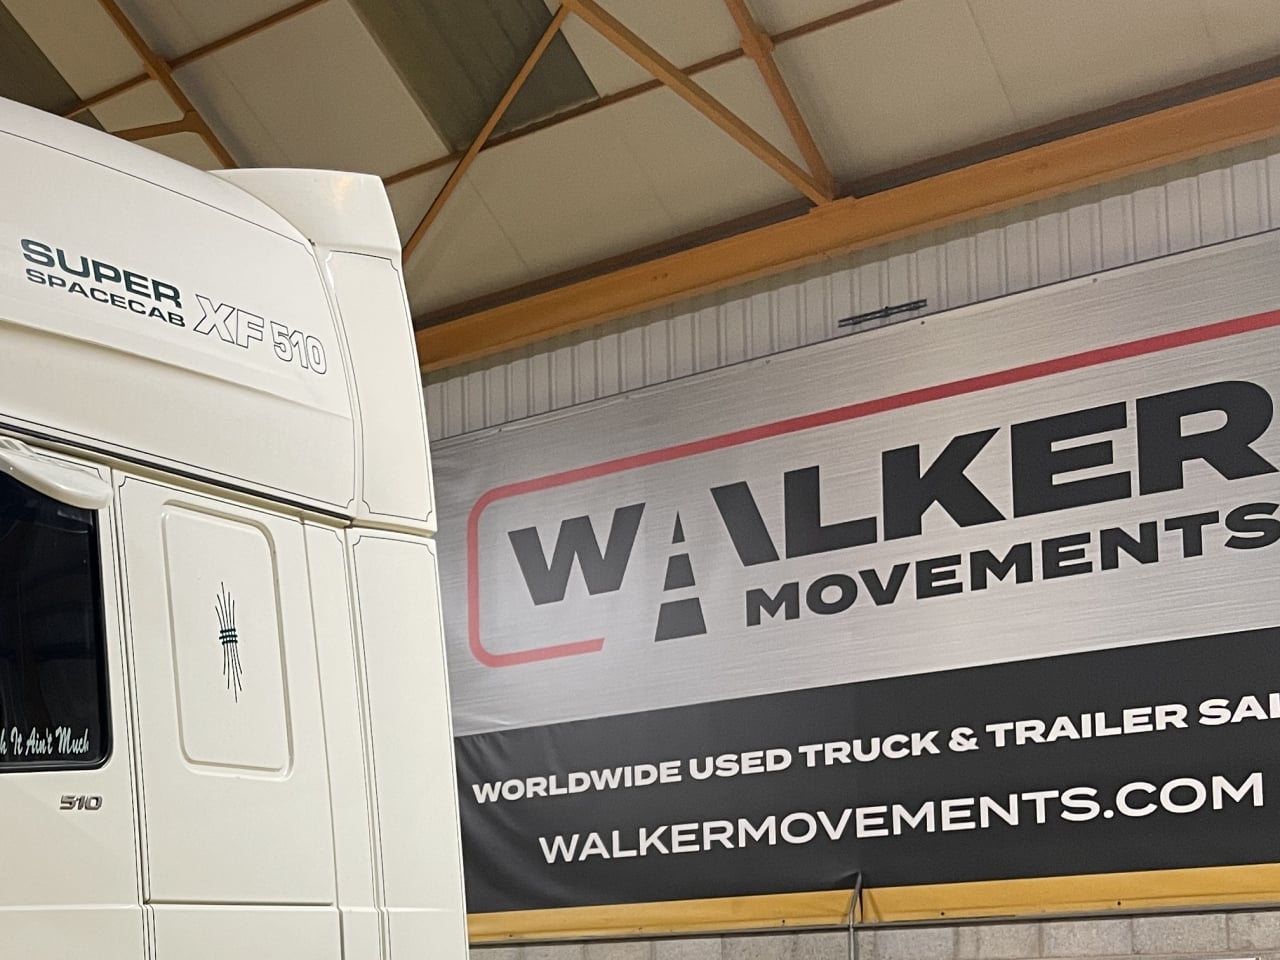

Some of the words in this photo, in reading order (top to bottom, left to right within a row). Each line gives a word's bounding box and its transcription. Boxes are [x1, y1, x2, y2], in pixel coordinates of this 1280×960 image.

[20, 238, 183, 309] SUPER
[25, 267, 186, 328] SPACECAB
[193, 294, 264, 349] XF
[270, 320, 327, 375] 510
[508, 380, 1279, 642] WALKER
[746, 502, 1280, 627] MOVEMENTS
[10, 726, 24, 755] It
[25, 726, 53, 756] Ain't
[55, 725, 89, 755] Much
[472, 760, 682, 804] WORLDWIDE
[689, 748, 792, 780] USED
[798, 730, 941, 768] TRUCK
[948, 727, 980, 752] &
[985, 703, 1189, 748] TRAILER
[59, 795, 103, 811] 510
[538, 772, 1264, 864] WALKERMOVEMENTS.COM
